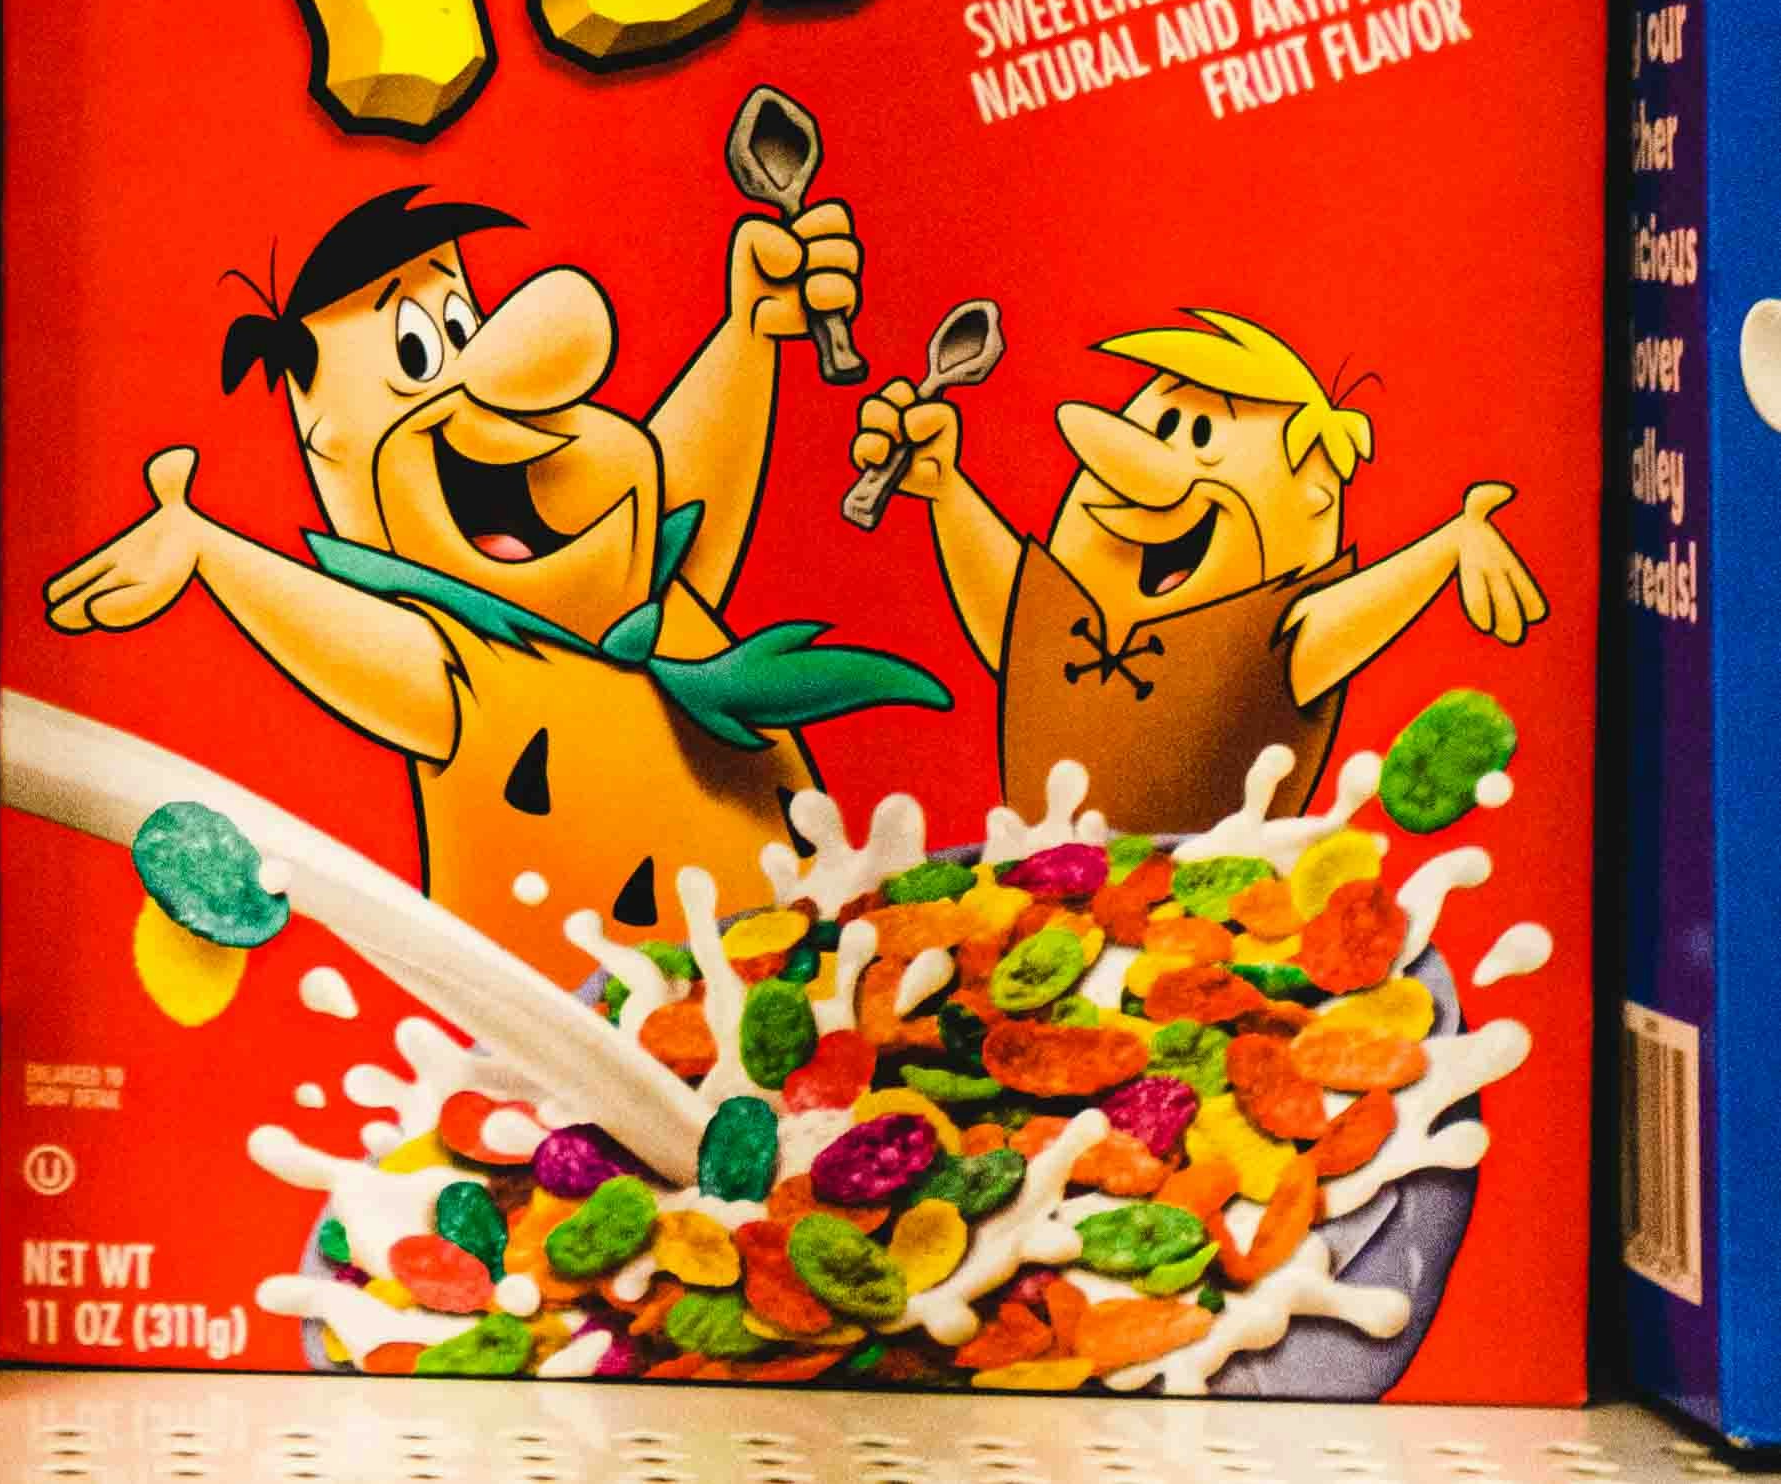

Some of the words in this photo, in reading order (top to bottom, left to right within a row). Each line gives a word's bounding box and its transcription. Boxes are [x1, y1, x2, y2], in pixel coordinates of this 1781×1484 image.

[970, 25, 1152, 125] NATURAL
[1200, 34, 1316, 119] FRUIT
[23, 1239, 89, 1287] NET
[96, 1243, 155, 1289] WT
[25, 1299, 58, 1345] 11
[75, 1301, 123, 1347] OZ
[133, 1304, 248, 1361] (311g)
